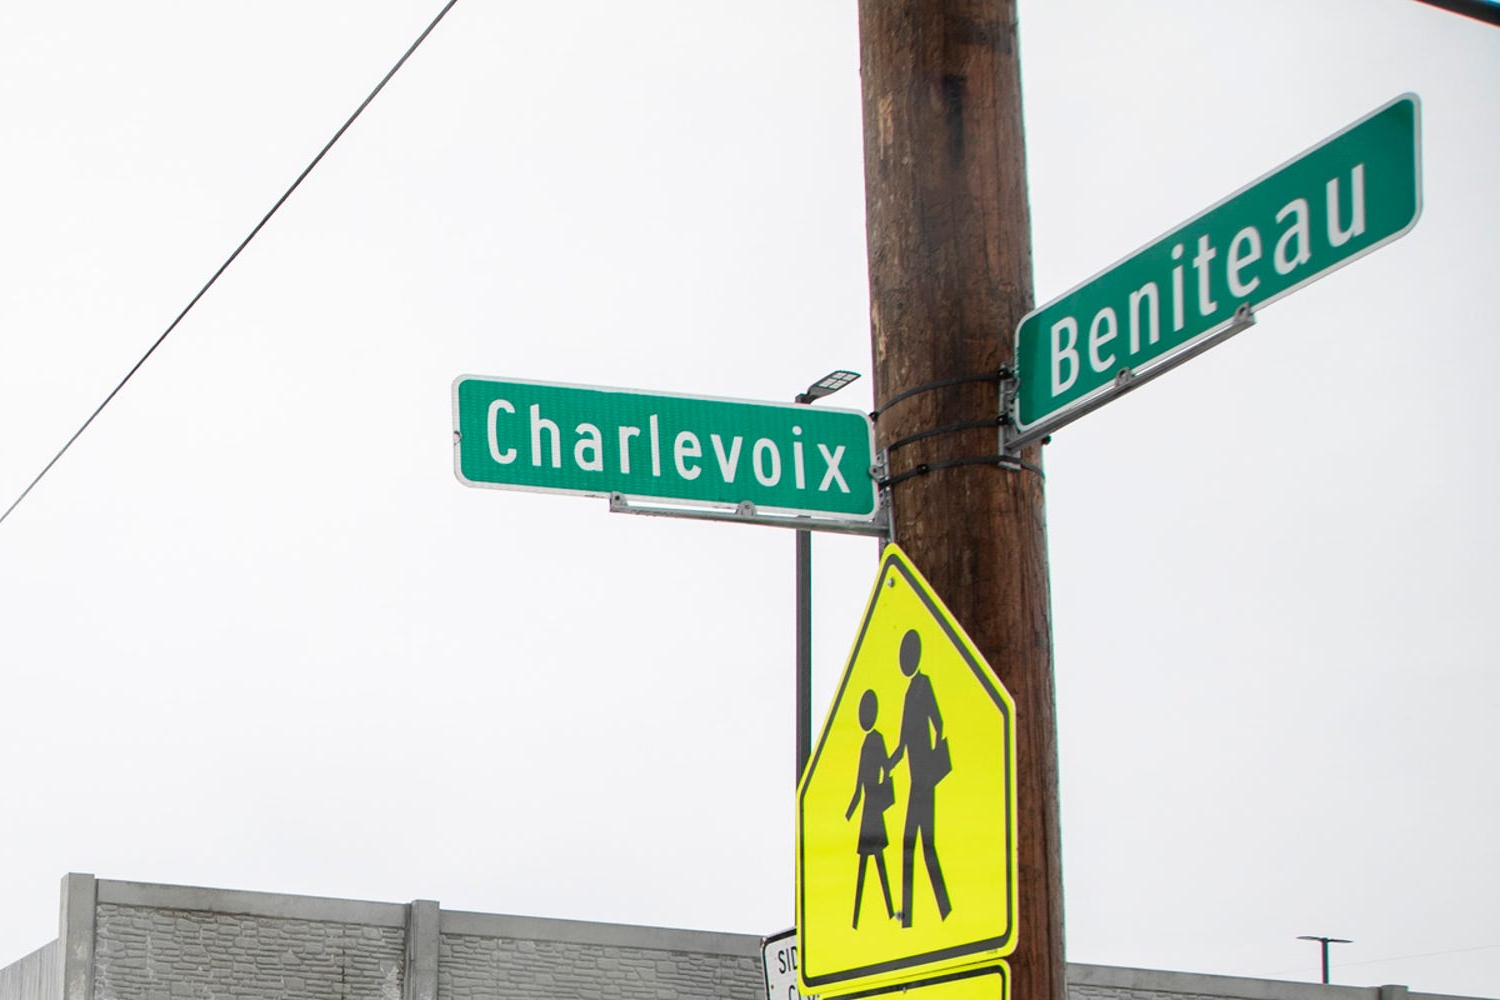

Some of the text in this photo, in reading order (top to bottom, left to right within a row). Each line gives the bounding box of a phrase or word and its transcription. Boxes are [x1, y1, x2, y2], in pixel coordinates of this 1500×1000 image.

[1050, 162, 1366, 398] Beniteau
[487, 399, 852, 493] Charlevoix
[777, 945, 798, 974] SID
